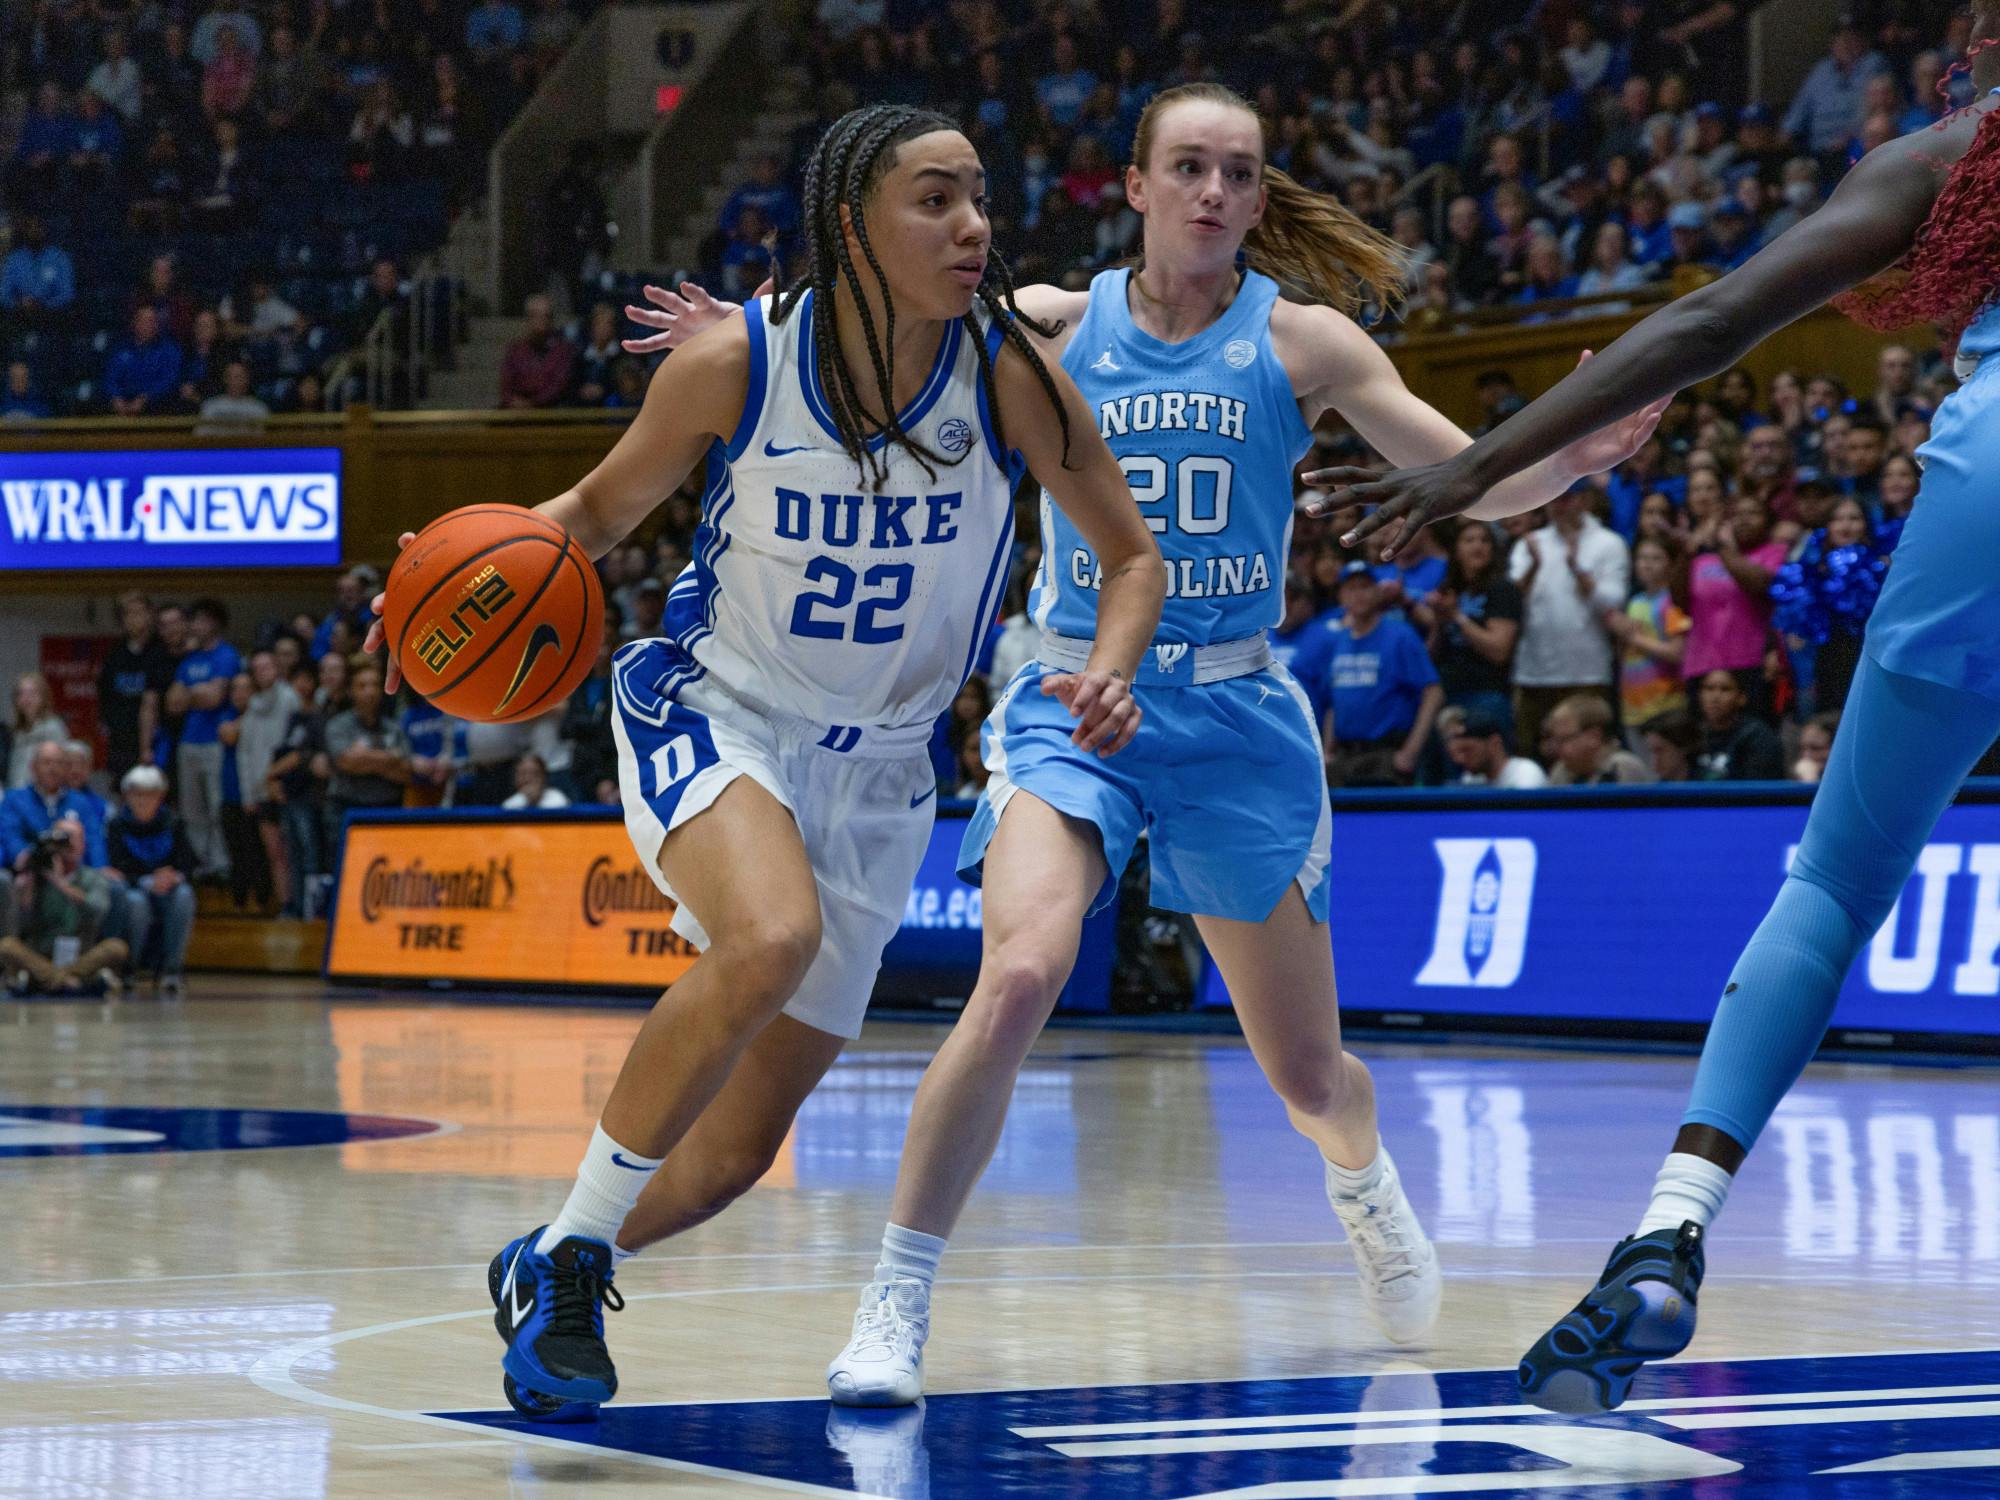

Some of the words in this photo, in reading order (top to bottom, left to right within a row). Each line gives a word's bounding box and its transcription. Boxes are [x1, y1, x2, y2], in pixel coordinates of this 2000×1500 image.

[1100, 391, 1247, 443] NORTH
[2, 477, 140, 542] WRAL
[160, 484, 328, 531] NEWS
[774, 486, 962, 548] DUKE
[1117, 454, 1234, 534] 20
[789, 555, 915, 644] 22
[1071, 548, 1271, 598] CLINA
[416, 571, 516, 675] ELITE
[361, 855, 497, 923] Continental
[397, 923, 464, 950] TIRE
